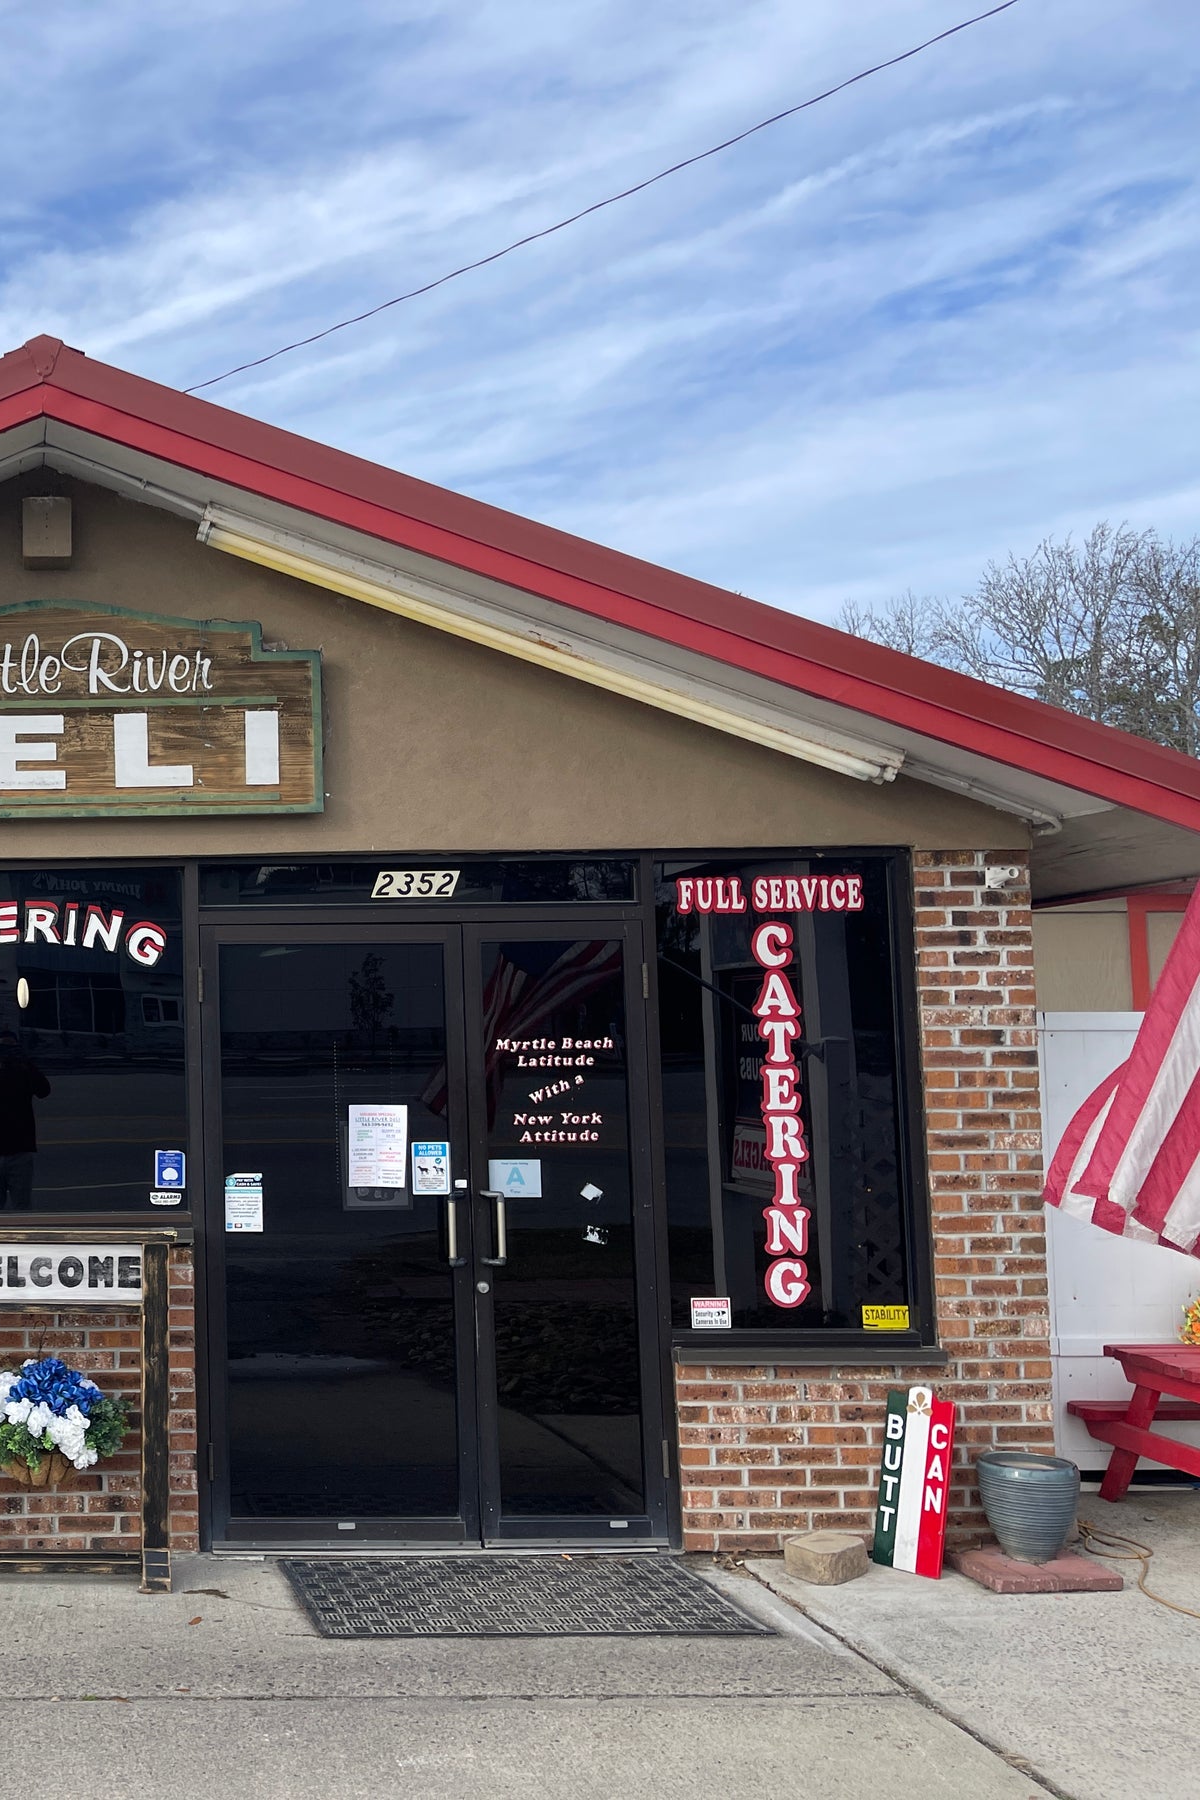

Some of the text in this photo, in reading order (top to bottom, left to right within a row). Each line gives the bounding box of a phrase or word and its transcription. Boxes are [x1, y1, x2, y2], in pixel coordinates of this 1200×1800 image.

[61, 632, 213, 694] River
[374, 872, 455, 896] 2352
[677, 874, 865, 914] FULL SERVICE
[495, 1036, 614, 1052] Myrtle Beach
[517, 1054, 595, 1067] Latitude
[528, 1073, 585, 1105] With a
[513, 1111, 603, 1126] New York
[751, 920, 811, 1307] CATERING
[519, 1130, 600, 1143] Attitude
[506, 1166, 526, 1185] A
[693, 1300, 728, 1308] WARNING
[695, 1310, 713, 1318] Security
[864, 1309, 909, 1321] STABILITY
[879, 1413, 904, 1533] BUTT
[924, 1423, 949, 1514] CAN
